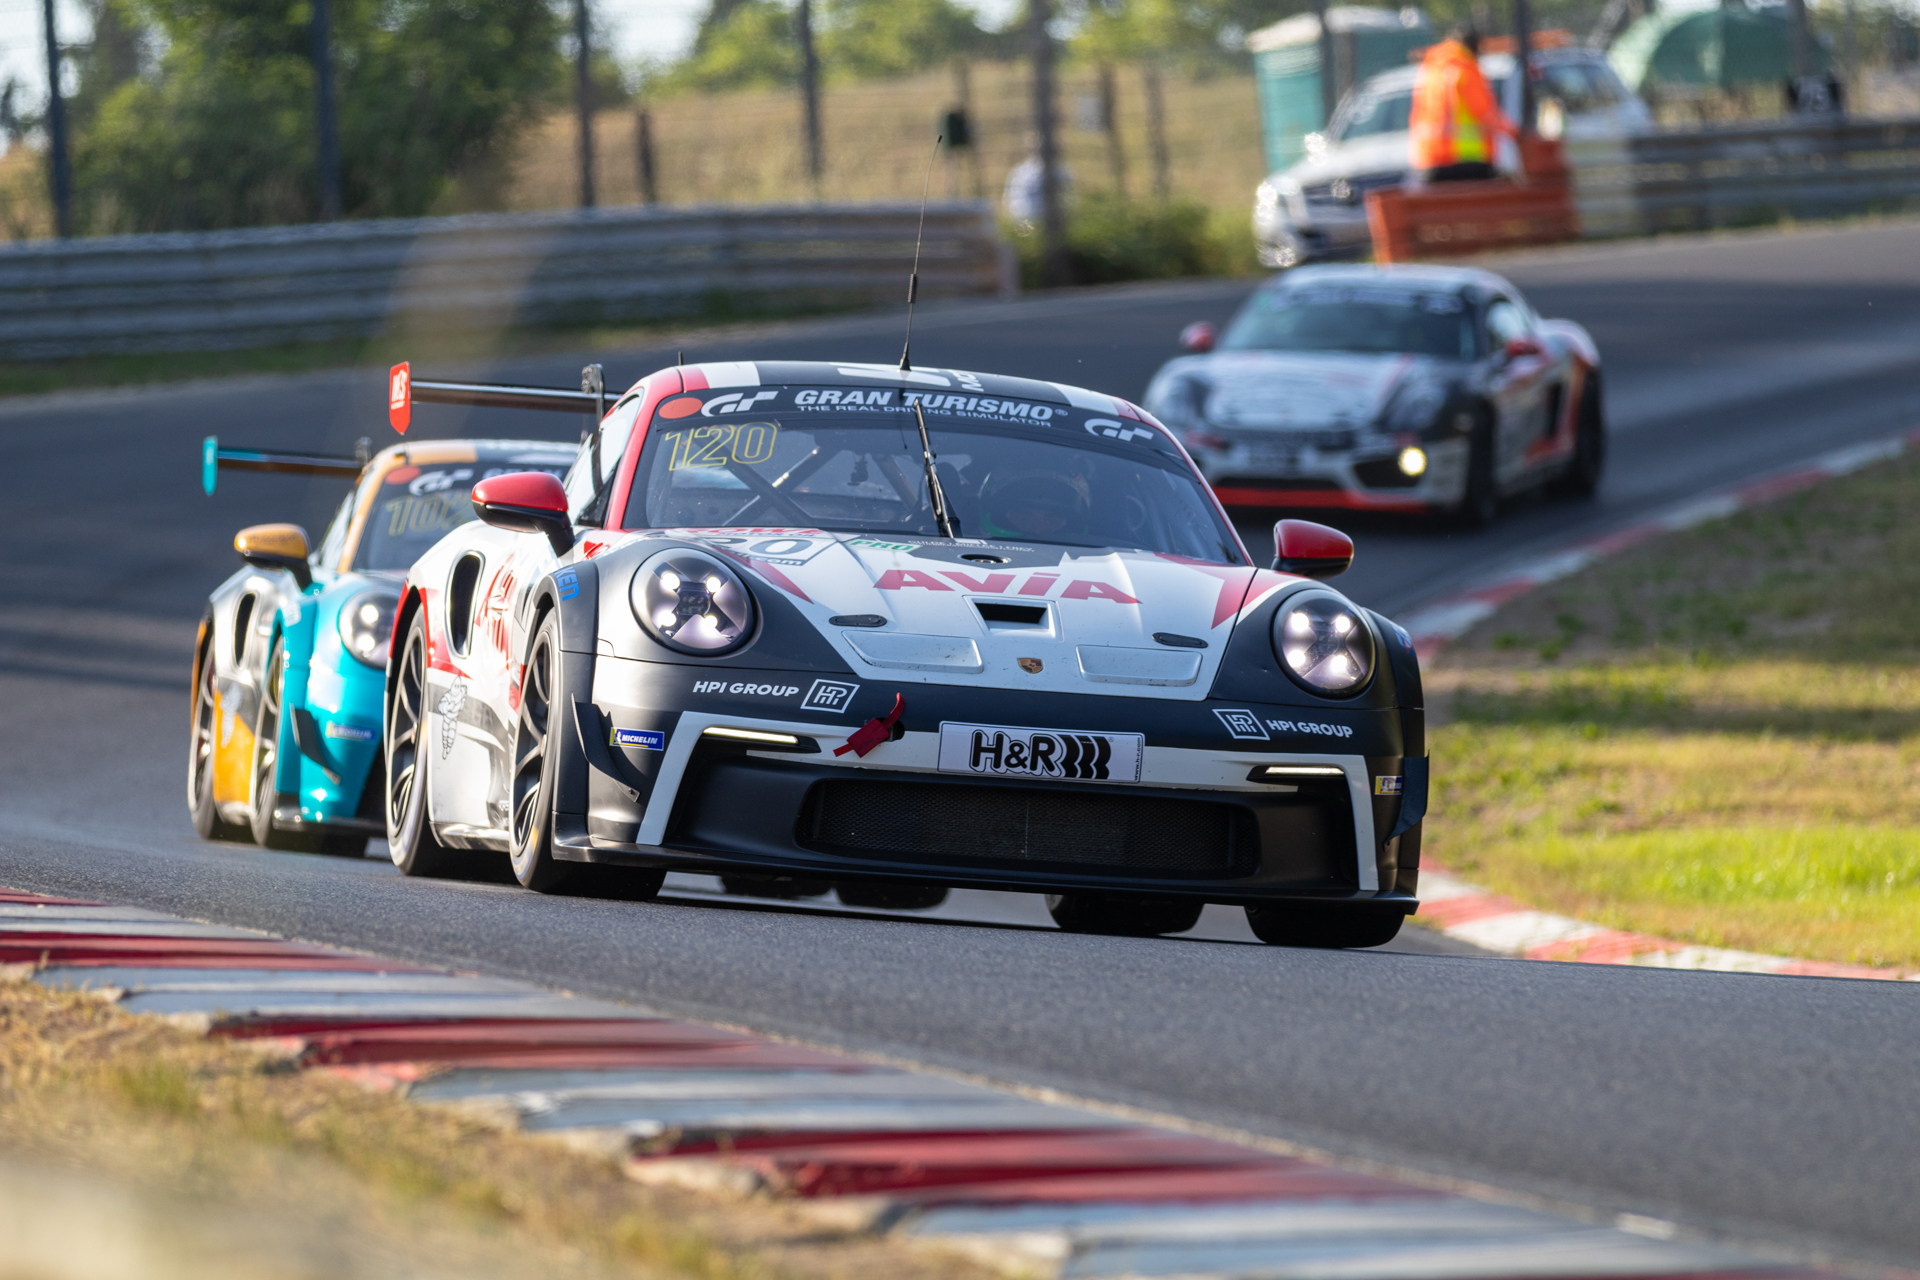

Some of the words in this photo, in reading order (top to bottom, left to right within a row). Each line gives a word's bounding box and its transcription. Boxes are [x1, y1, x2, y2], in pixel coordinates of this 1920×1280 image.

[794, 390, 893, 405] GRAN
[902, 392, 1053, 420] TURISMO
[883, 406, 952, 416] DRIVNG
[956, 410, 1052, 428] SIMULATOR
[665, 421, 777, 471] 120
[850, 540, 915, 551] PRO
[692, 681, 728, 694] HPI
[729, 683, 800, 697] GROUP
[1265, 719, 1298, 732] HPI
[1298, 722, 1354, 738] GROUP
[622, 734, 658, 745] MICHELIN
[971, 731, 1060, 774] H&R
